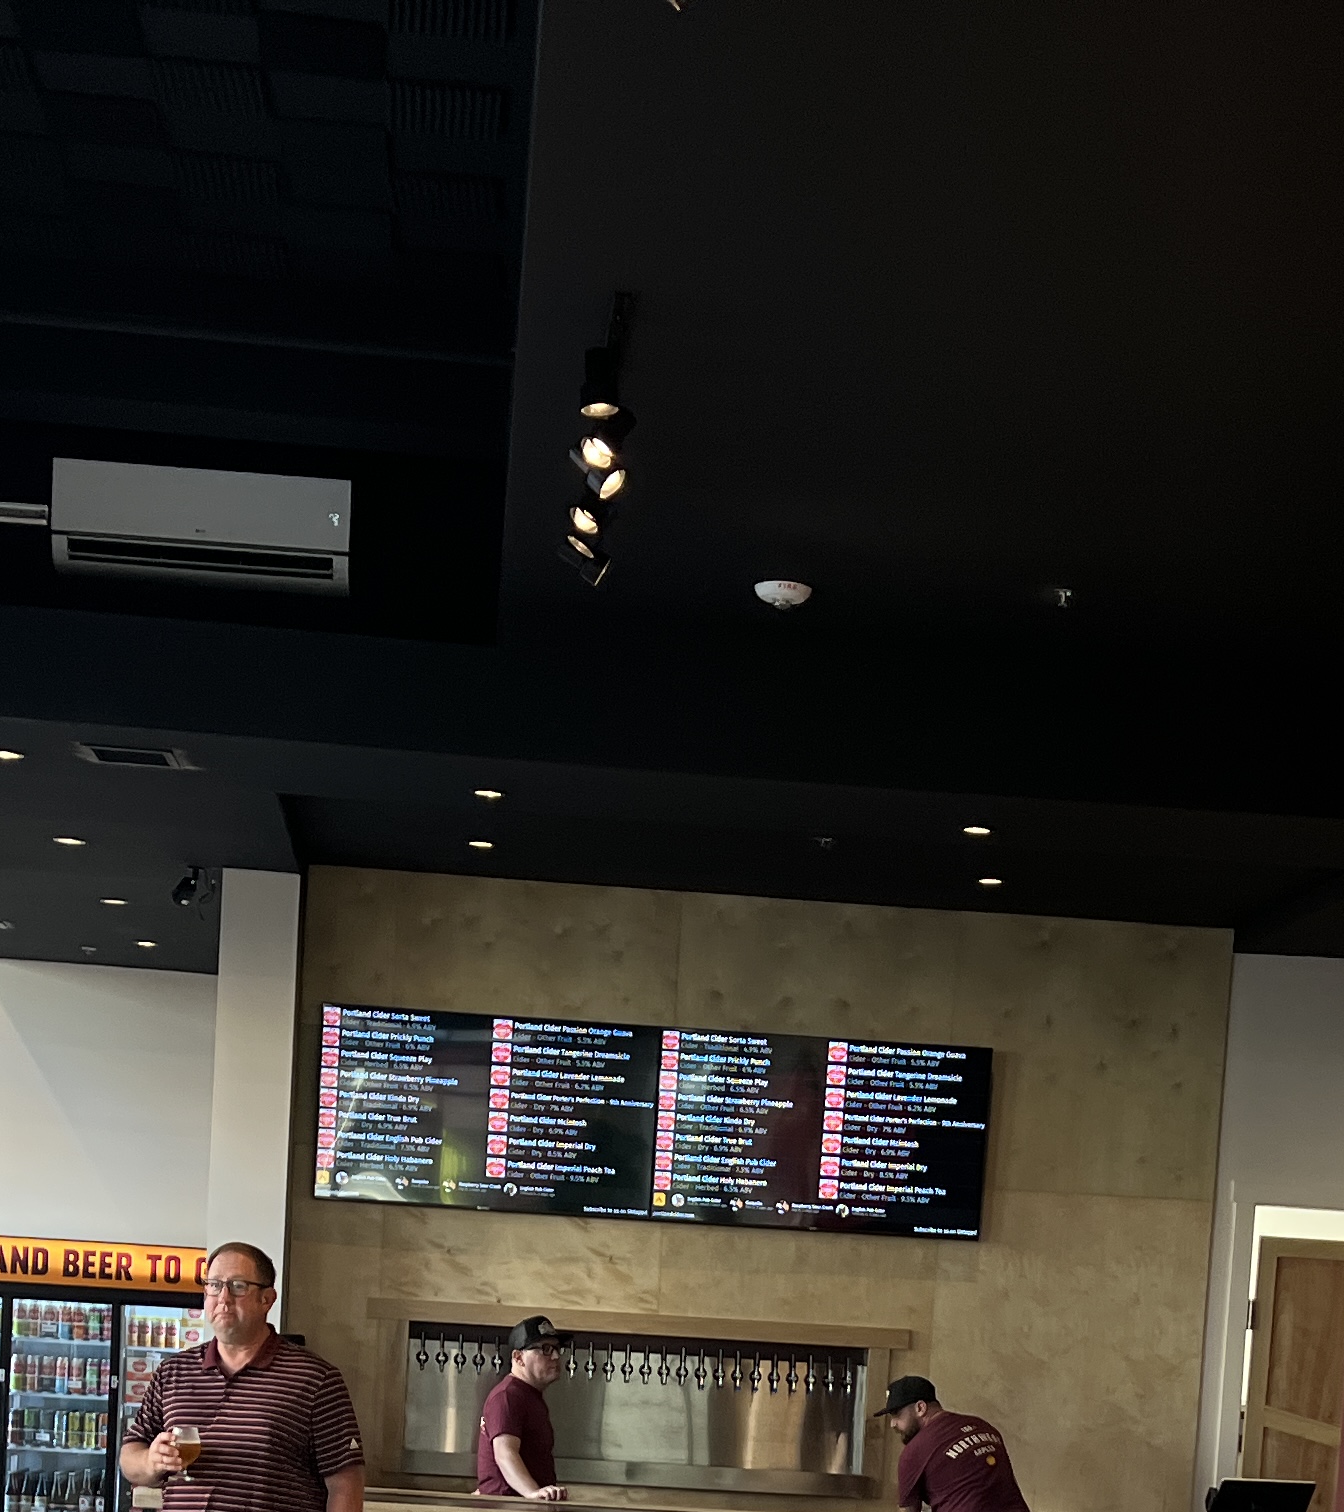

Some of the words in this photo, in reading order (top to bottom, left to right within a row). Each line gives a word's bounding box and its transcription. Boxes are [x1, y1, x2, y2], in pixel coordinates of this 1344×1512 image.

[343, 1010, 371, 1018] Portland
[515, 1023, 542, 1031] Portland
[544, 1025, 561, 1033] Cider
[342, 1030, 370, 1039] Portland
[372, 1032, 389, 1040] Cider
[682, 1033, 709, 1042] Portland
[711, 1035, 728, 1043] Cider
[513, 1046, 542, 1054] Portland
[543, 1048, 560, 1056] Cider
[850, 1045, 877, 1054] Portland
[341, 1050, 369, 1059] Portland
[680, 1054, 708, 1062] Portland
[709, 1056, 726, 1064] Cider
[340, 1071, 368, 1079] Portland
[370, 1073, 387, 1081] Cider
[512, 1069, 540, 1077] Portland
[848, 1068, 876, 1077] Portland
[877, 1070, 894, 1078] Cider
[679, 1074, 707, 1082] Portland
[708, 1076, 725, 1084] Cider
[339, 1091, 367, 1100] Portland
[678, 1094, 705, 1102] Portland
[846, 1091, 874, 1100] Portland
[875, 1093, 892, 1101] Cider
[339, 1111, 366, 1120] Portland
[510, 1115, 538, 1124] Portland
[539, 1117, 556, 1125] Cider
[677, 1114, 704, 1122] Portland
[338, 1131, 365, 1140] Portland
[676, 1134, 703, 1142] Portland
[704, 1136, 722, 1144] Cider
[509, 1138, 536, 1147] Portland
[538, 1140, 555, 1148] Cider
[843, 1137, 870, 1145] Portland
[337, 1152, 364, 1160] Portland
[675, 1154, 702, 1163] Portland
[508, 1161, 535, 1170] Portland
[842, 1159, 869, 1168] Portland
[673, 1174, 700, 1182] Portland
[702, 1176, 719, 1184] Cider
[840, 1182, 867, 1191] Portland
[62, 1248, 134, 1282] BEER
[146, 1254, 182, 1284] TO
